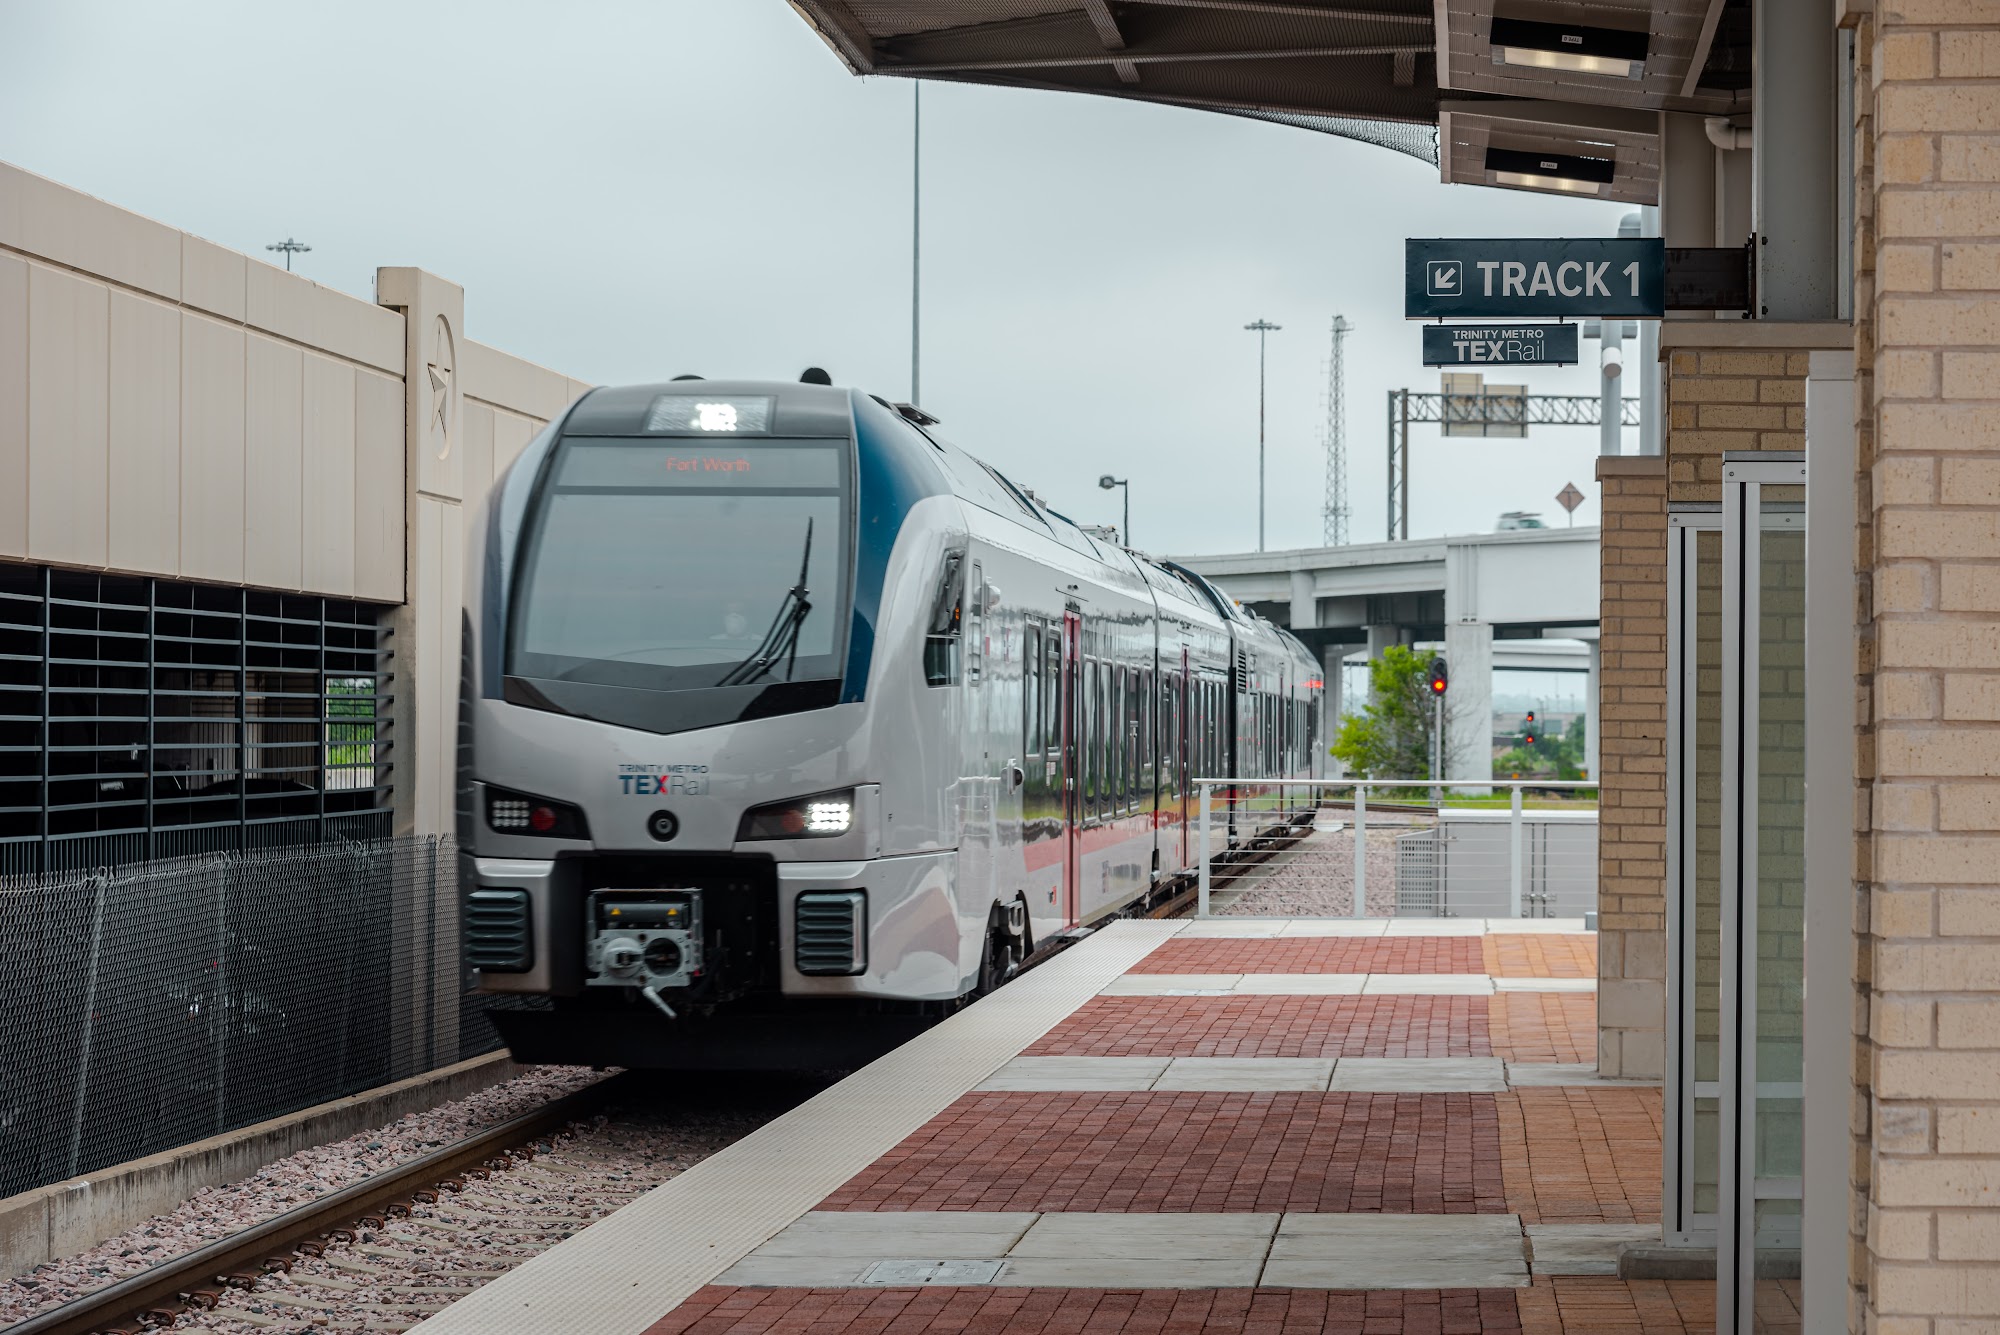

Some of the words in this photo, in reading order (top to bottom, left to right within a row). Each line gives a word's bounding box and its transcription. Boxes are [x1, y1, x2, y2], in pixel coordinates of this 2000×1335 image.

[1476, 261, 1612, 297] TRACK
[1622, 261, 1640, 297] 1
[1452, 329, 1499, 340] TRINITY
[1501, 329, 1544, 339] METRO
[1452, 340, 1545, 362] TEXRail
[666, 457, 698, 472] Fort
[703, 457, 751, 472] Worth
[618, 764, 663, 773] TRINITY
[666, 764, 710, 774] METRO
[618, 774, 711, 796] TEXRail
